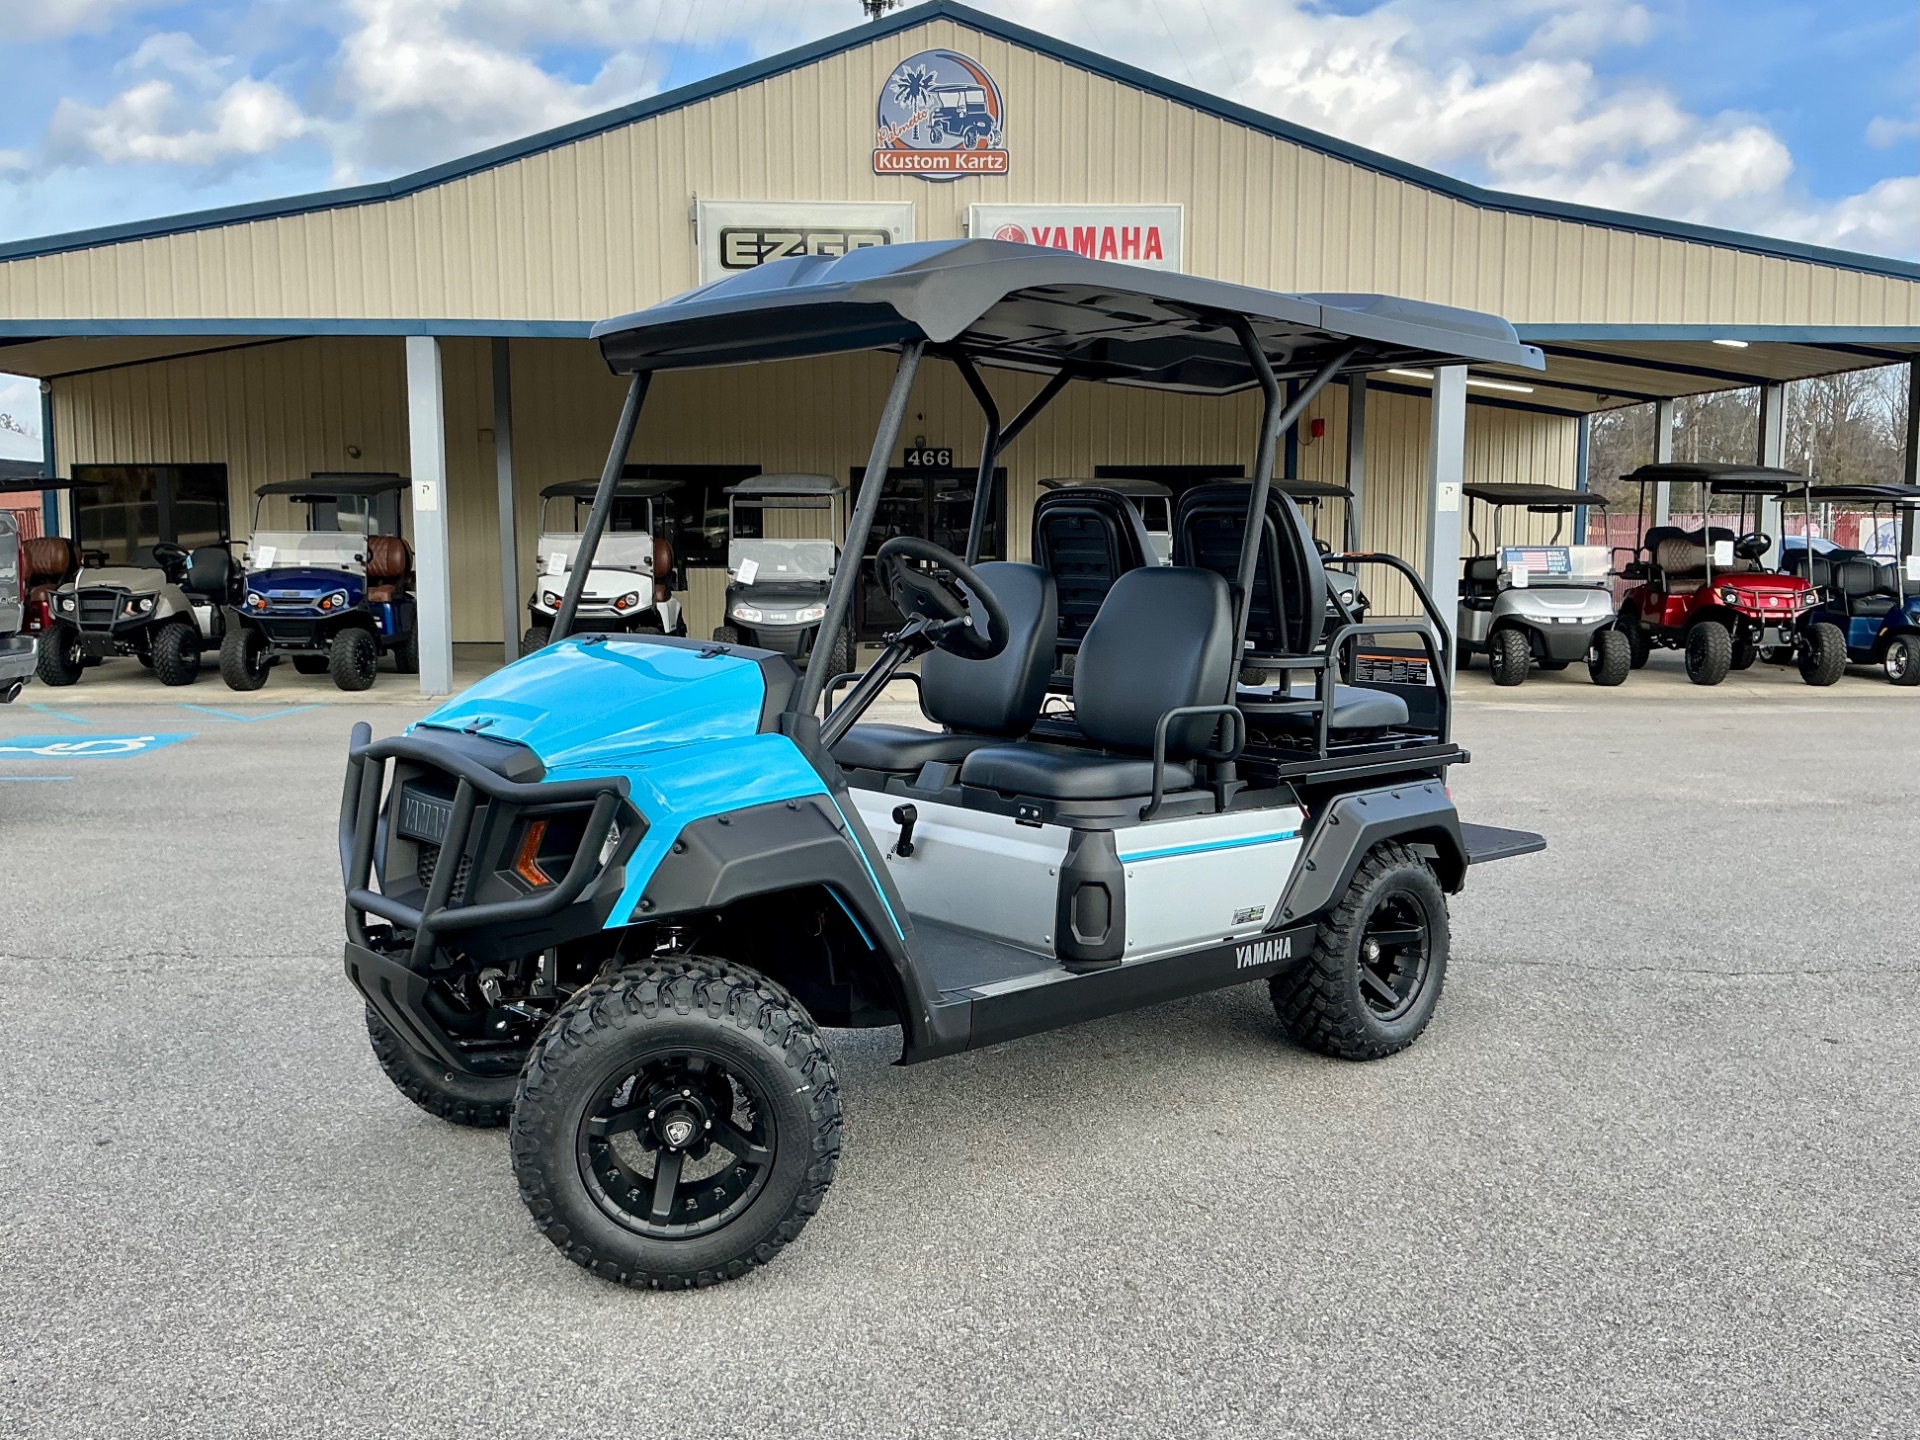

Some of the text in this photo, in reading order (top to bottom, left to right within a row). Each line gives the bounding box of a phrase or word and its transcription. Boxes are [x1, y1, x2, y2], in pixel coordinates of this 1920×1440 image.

[878, 109, 928, 146] Palmetto
[880, 153, 1003, 168] Kustom Kartz
[1032, 226, 1162, 260] YAMAHA
[907, 450, 949, 466] 466
[1235, 936, 1292, 969] YAMAHA
